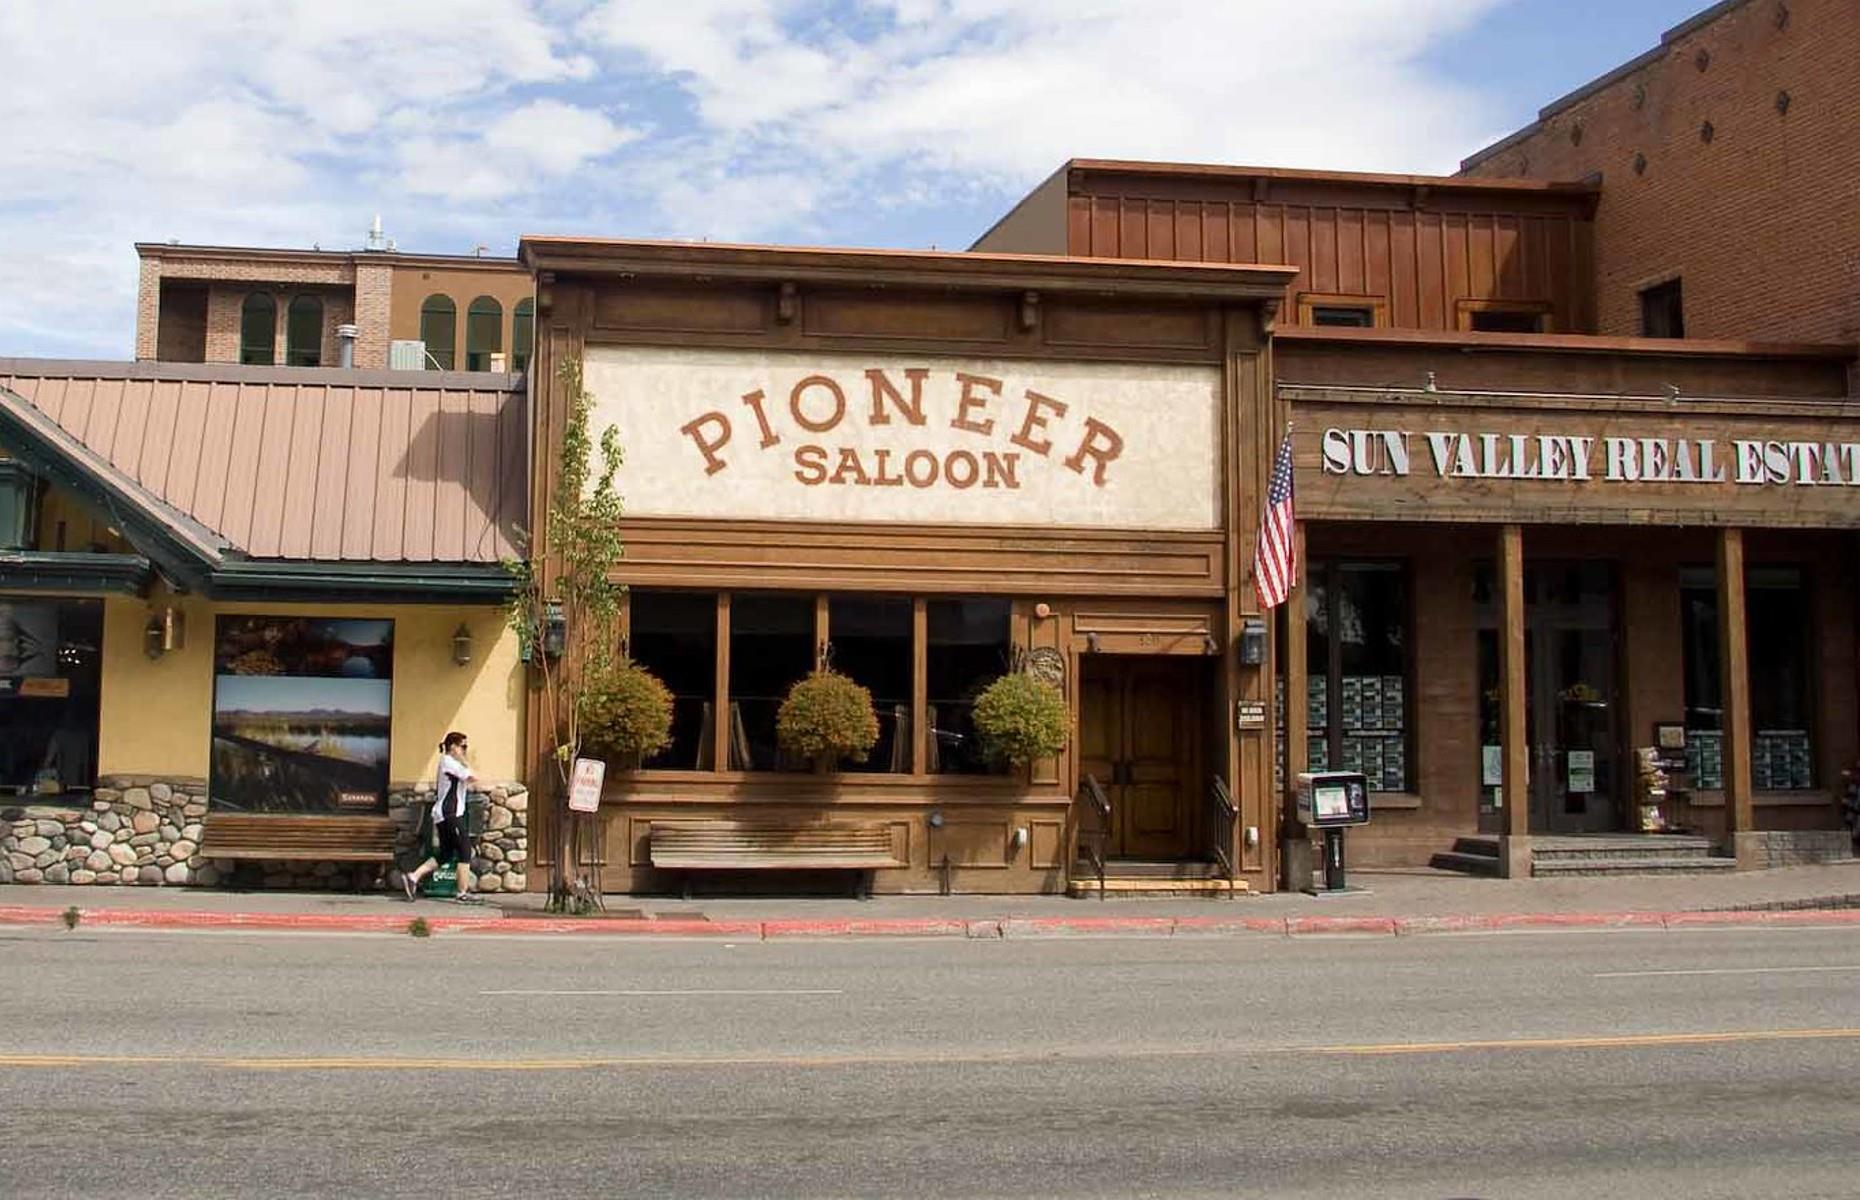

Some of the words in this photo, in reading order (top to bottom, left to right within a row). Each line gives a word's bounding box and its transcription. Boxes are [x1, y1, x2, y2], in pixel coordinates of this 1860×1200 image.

[681, 368, 1124, 487] PIONEER
[794, 444, 1020, 487] SALOON
[1323, 428, 1415, 475] SUN
[1424, 431, 1596, 480] VALLEY
[1604, 437, 1726, 482] REAL
